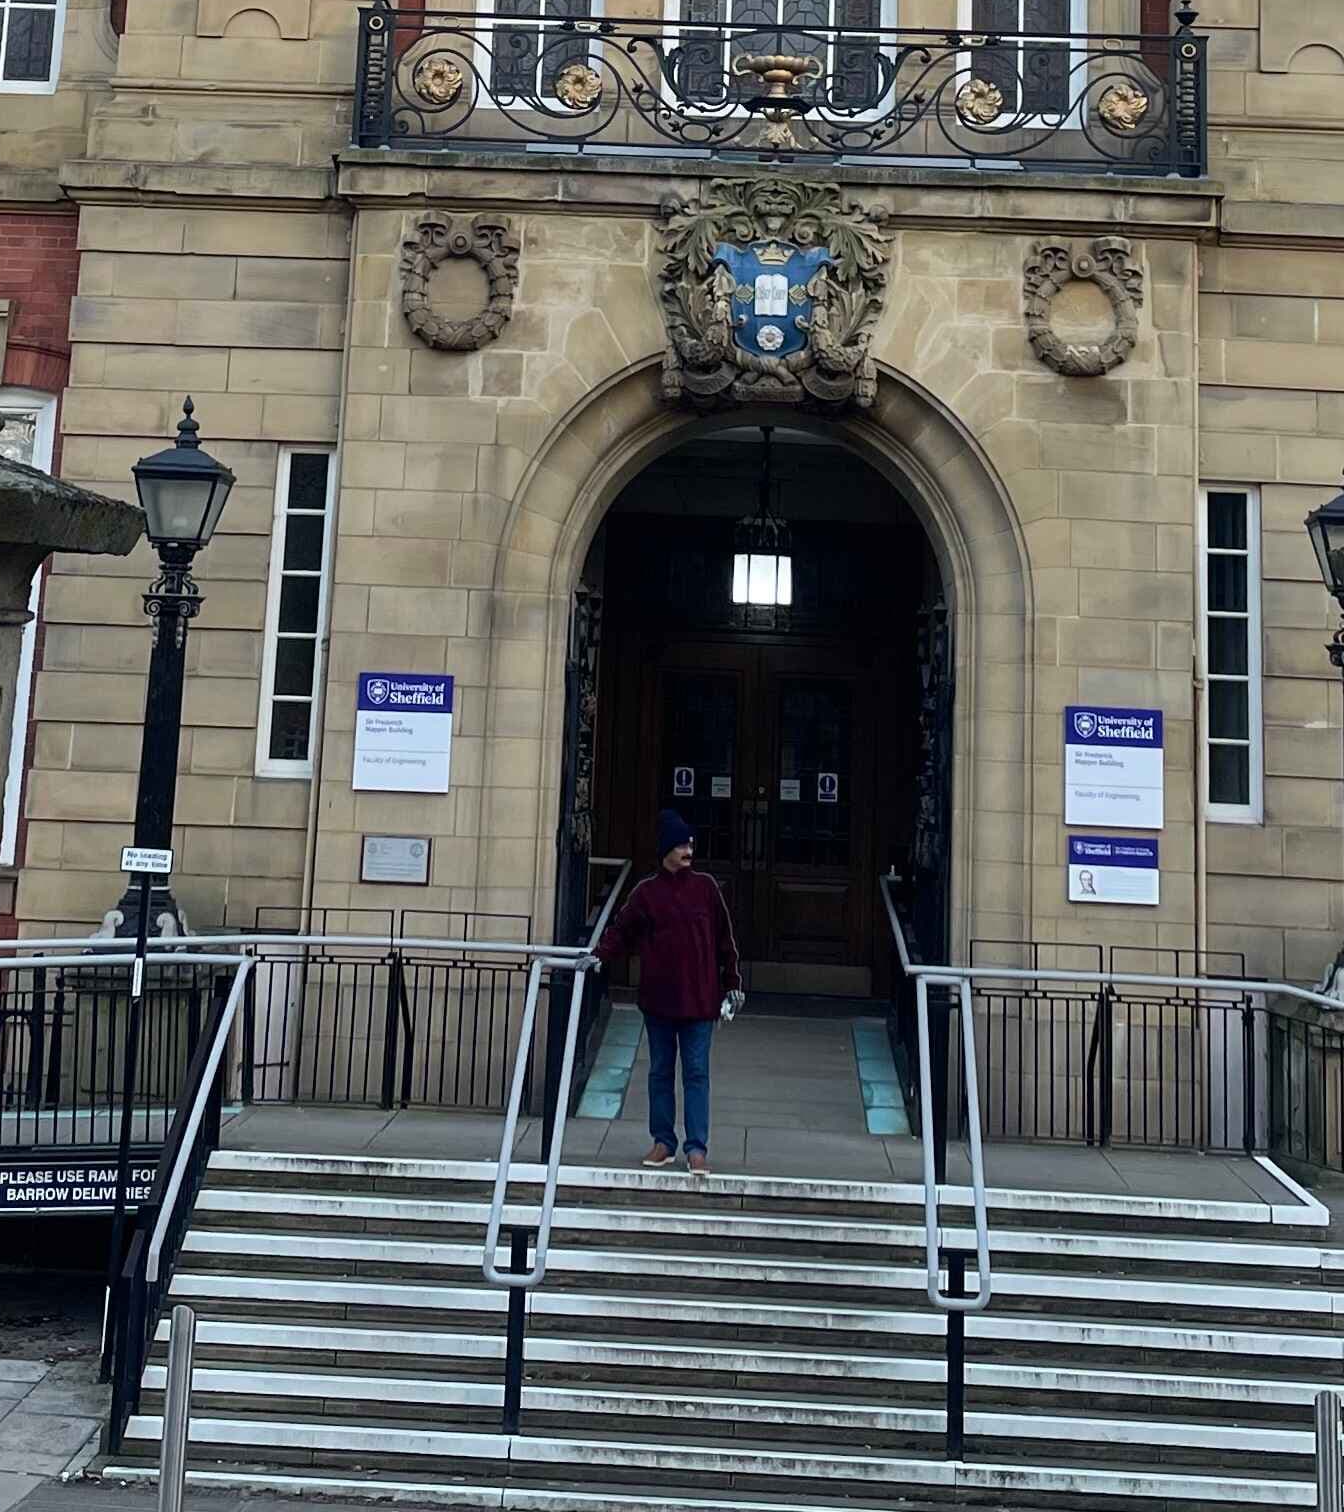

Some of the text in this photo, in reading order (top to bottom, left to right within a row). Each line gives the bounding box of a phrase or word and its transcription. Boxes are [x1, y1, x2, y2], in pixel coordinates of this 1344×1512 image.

[391, 681, 445, 693] University of
[389, 692, 444, 705] Sheffield
[1098, 715, 1154, 728] University of
[1097, 725, 1154, 740] Sheffield
[127, 850, 168, 861] No loading
[0, 1170, 53, 1185] PLEASE
[56, 1169, 85, 1183] USE
[88, 1169, 119, 1183] RAM
[6, 1187, 69, 1201] BARROW
